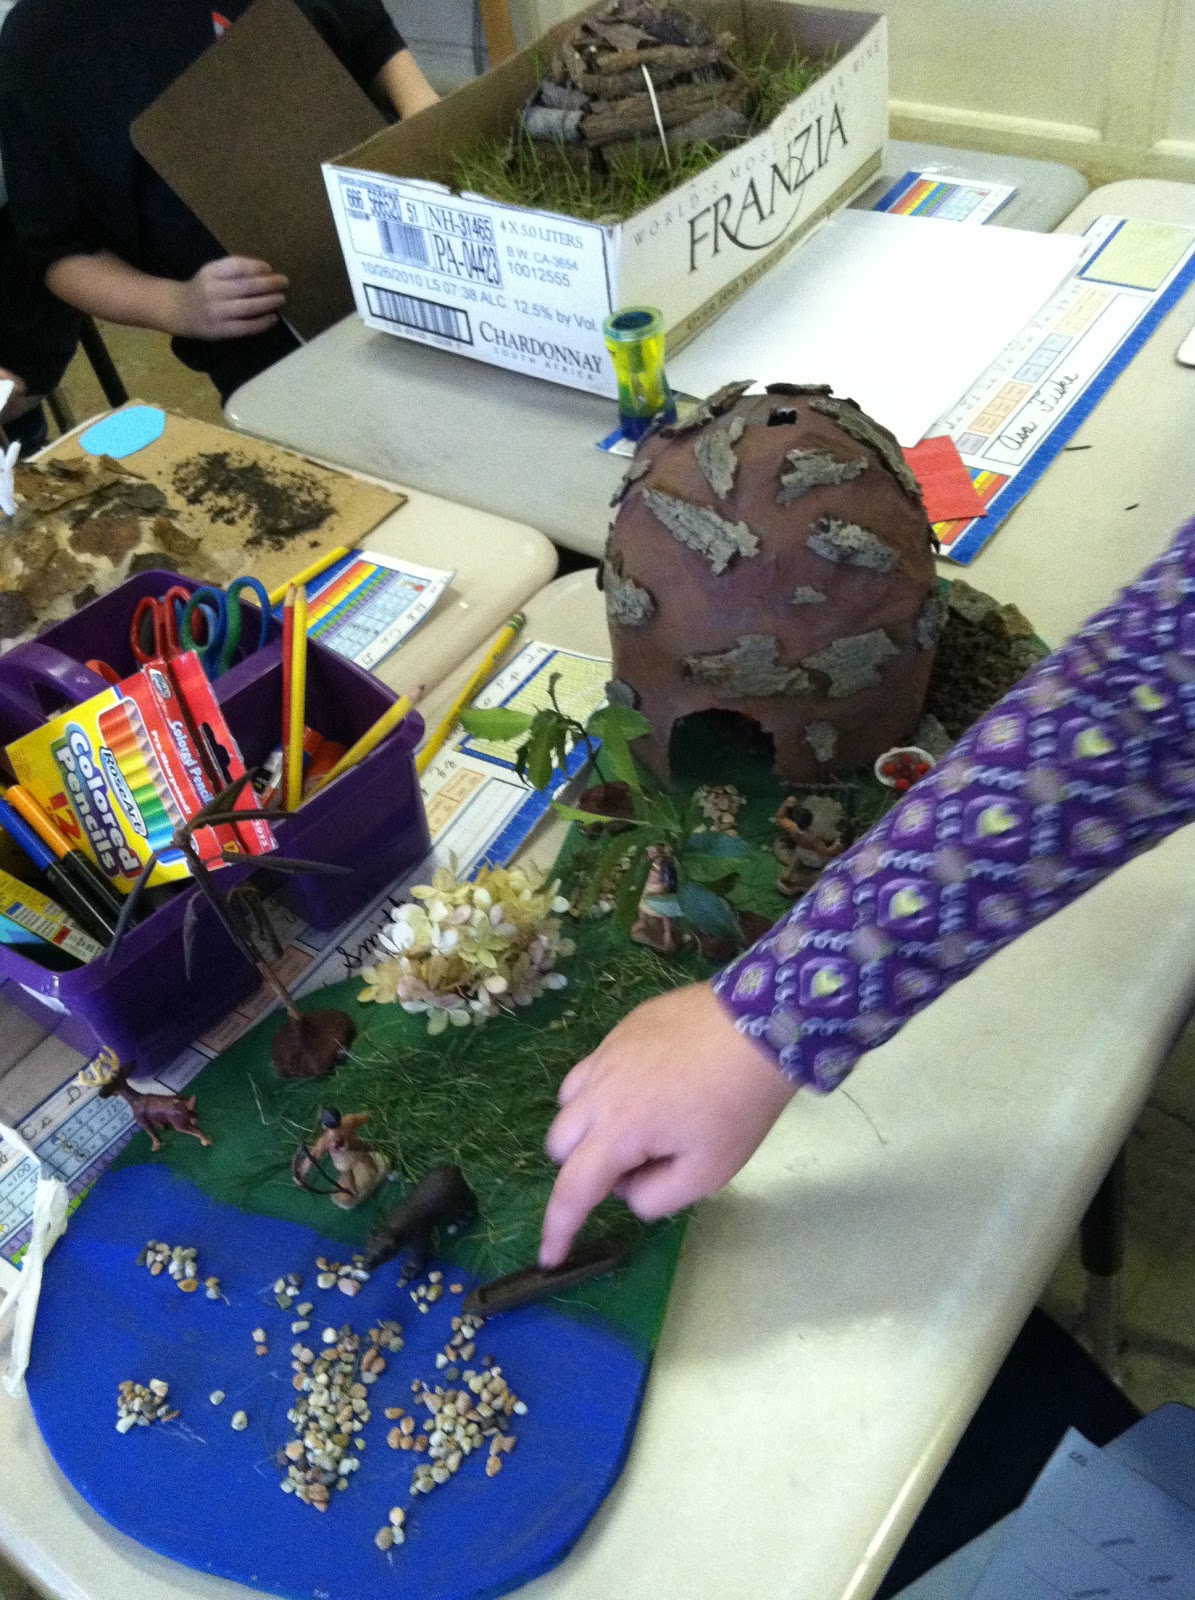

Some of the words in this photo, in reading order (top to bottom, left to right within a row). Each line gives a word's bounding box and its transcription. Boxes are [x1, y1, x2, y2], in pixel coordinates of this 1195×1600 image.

[686, 101, 849, 275] FRANZIA
[433, 233, 502, 285] PA-04423
[539, 228, 583, 249] LITERS
[508, 262, 571, 287] 10012555
[515, 300, 553, 321] 12.5%
[556, 309, 571, 325] by
[479, 321, 602, 374] CHARDONNAY
[493, 347, 536, 364] SOUTH
[545, 361, 594, 380] AFRICA
[170, 720, 198, 769] Colored
[190, 764, 216, 806] Pencil
[55, 745, 116, 870] Pencils
[69, 731, 141, 871] Colored
